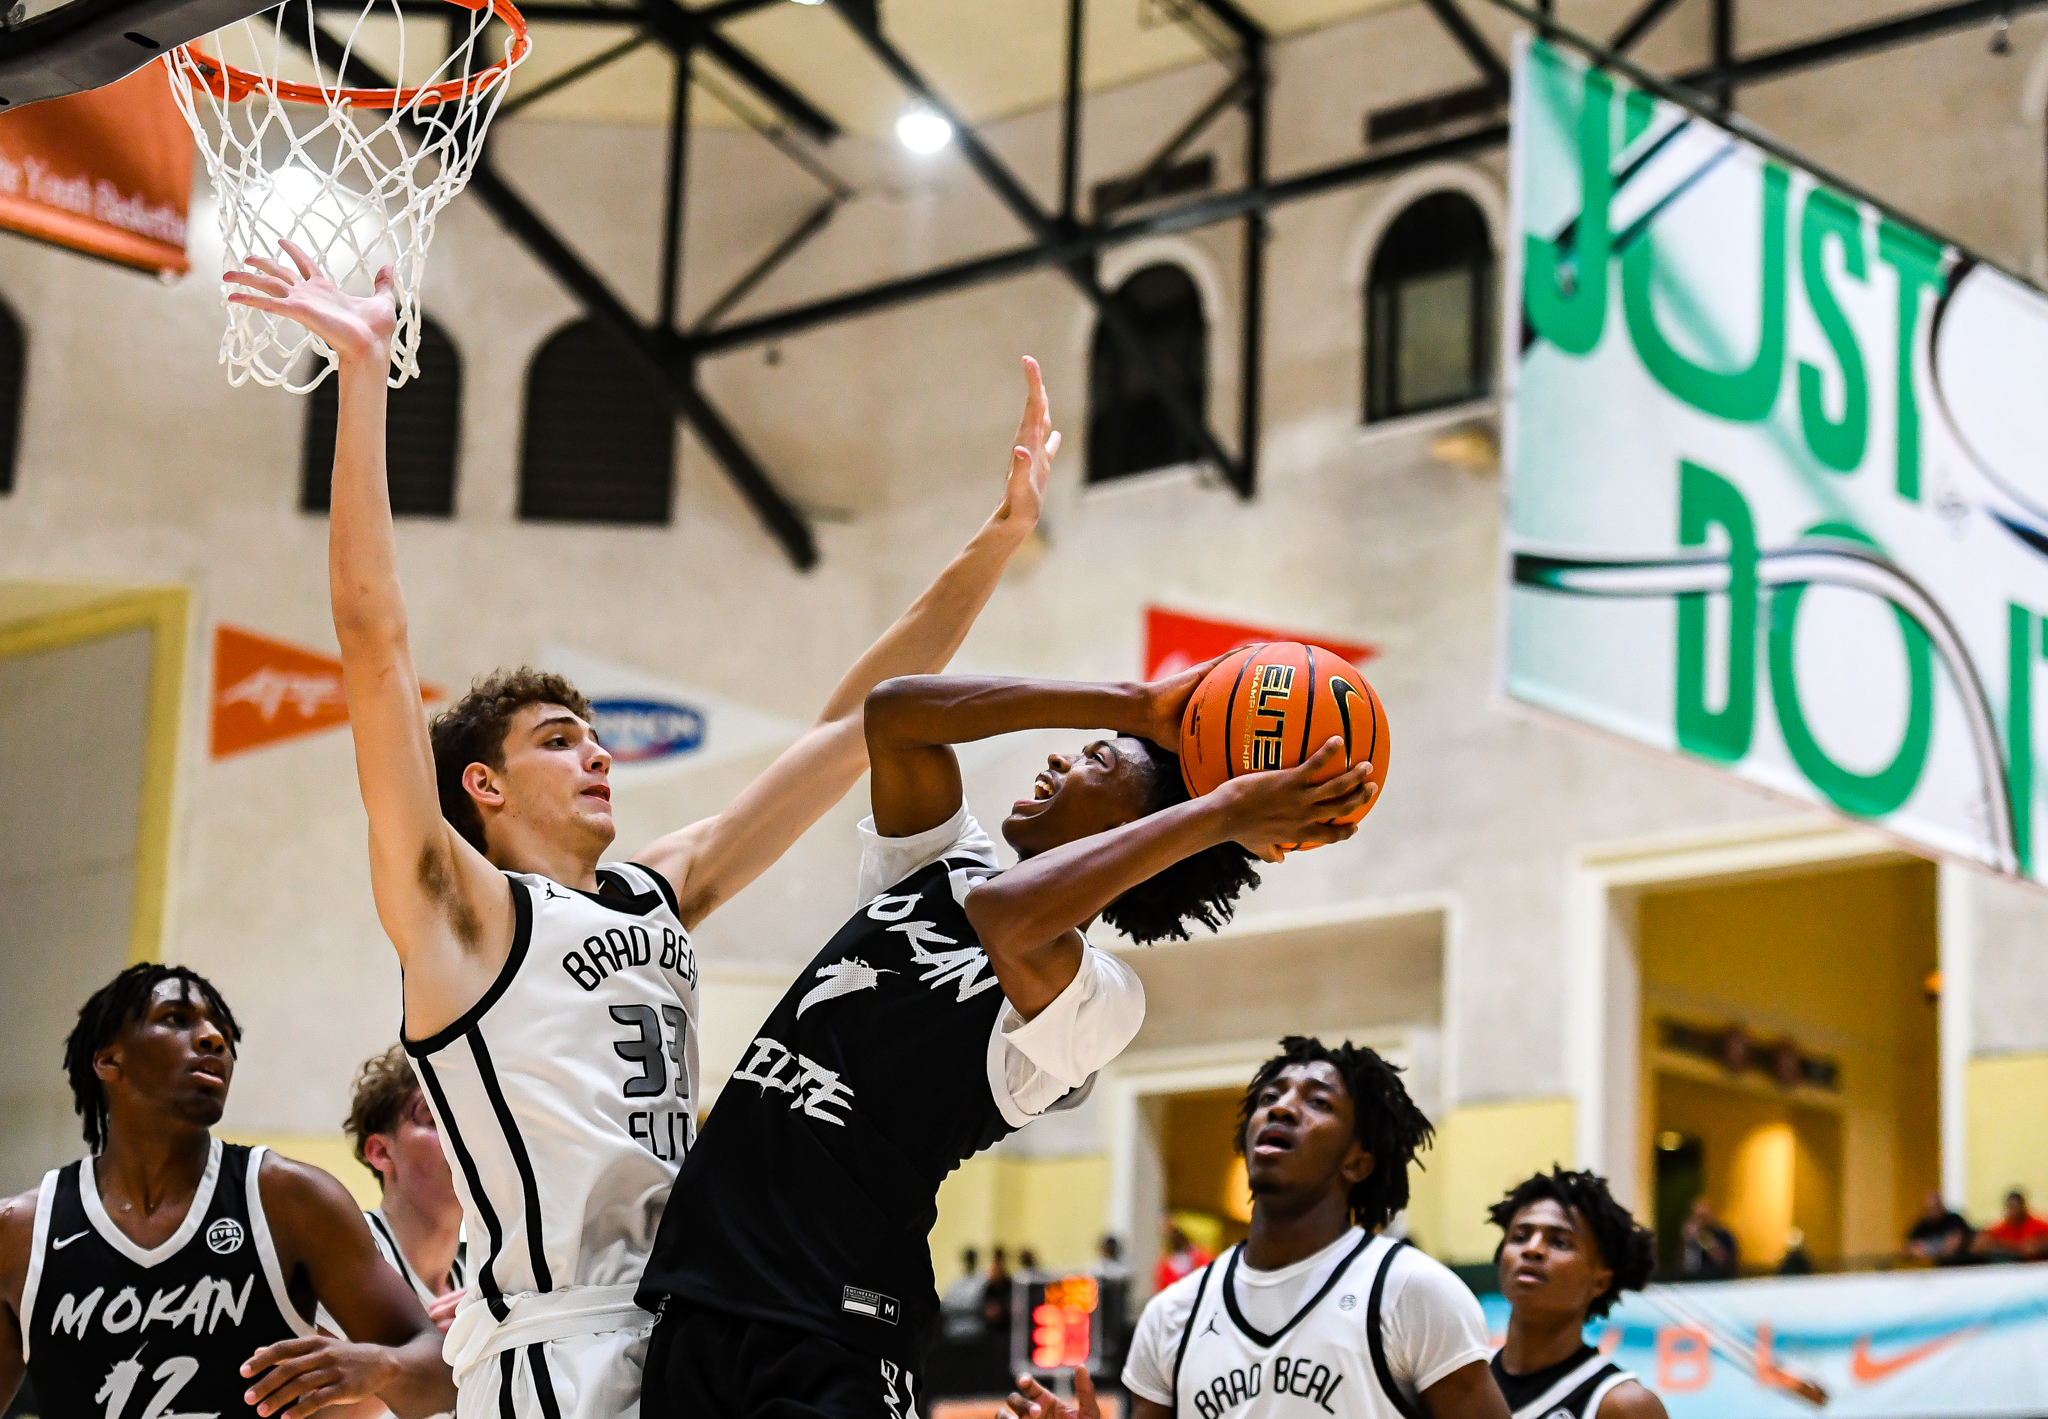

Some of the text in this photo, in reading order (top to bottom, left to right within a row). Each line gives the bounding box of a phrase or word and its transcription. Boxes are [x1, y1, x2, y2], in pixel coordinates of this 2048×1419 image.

[1526, 65, 1948, 504] JUST
[1677, 457, 2048, 876] DO I
[1242, 664, 1264, 770] CHAMPIONSHIP
[1251, 664, 1296, 771] ELITE
[562, 925, 699, 992] BRAD BEA
[867, 892, 999, 1003] OKAN
[608, 1003, 690, 1100] 33
[732, 1037, 855, 1127] ELITE
[628, 1111, 696, 1162] ELIT
[211, 1228, 240, 1240] EYBL
[51, 1273, 255, 1341] MOKAN
[884, 1303, 895, 1317] M
[1194, 1356, 1344, 1419] BRAD BEAL
